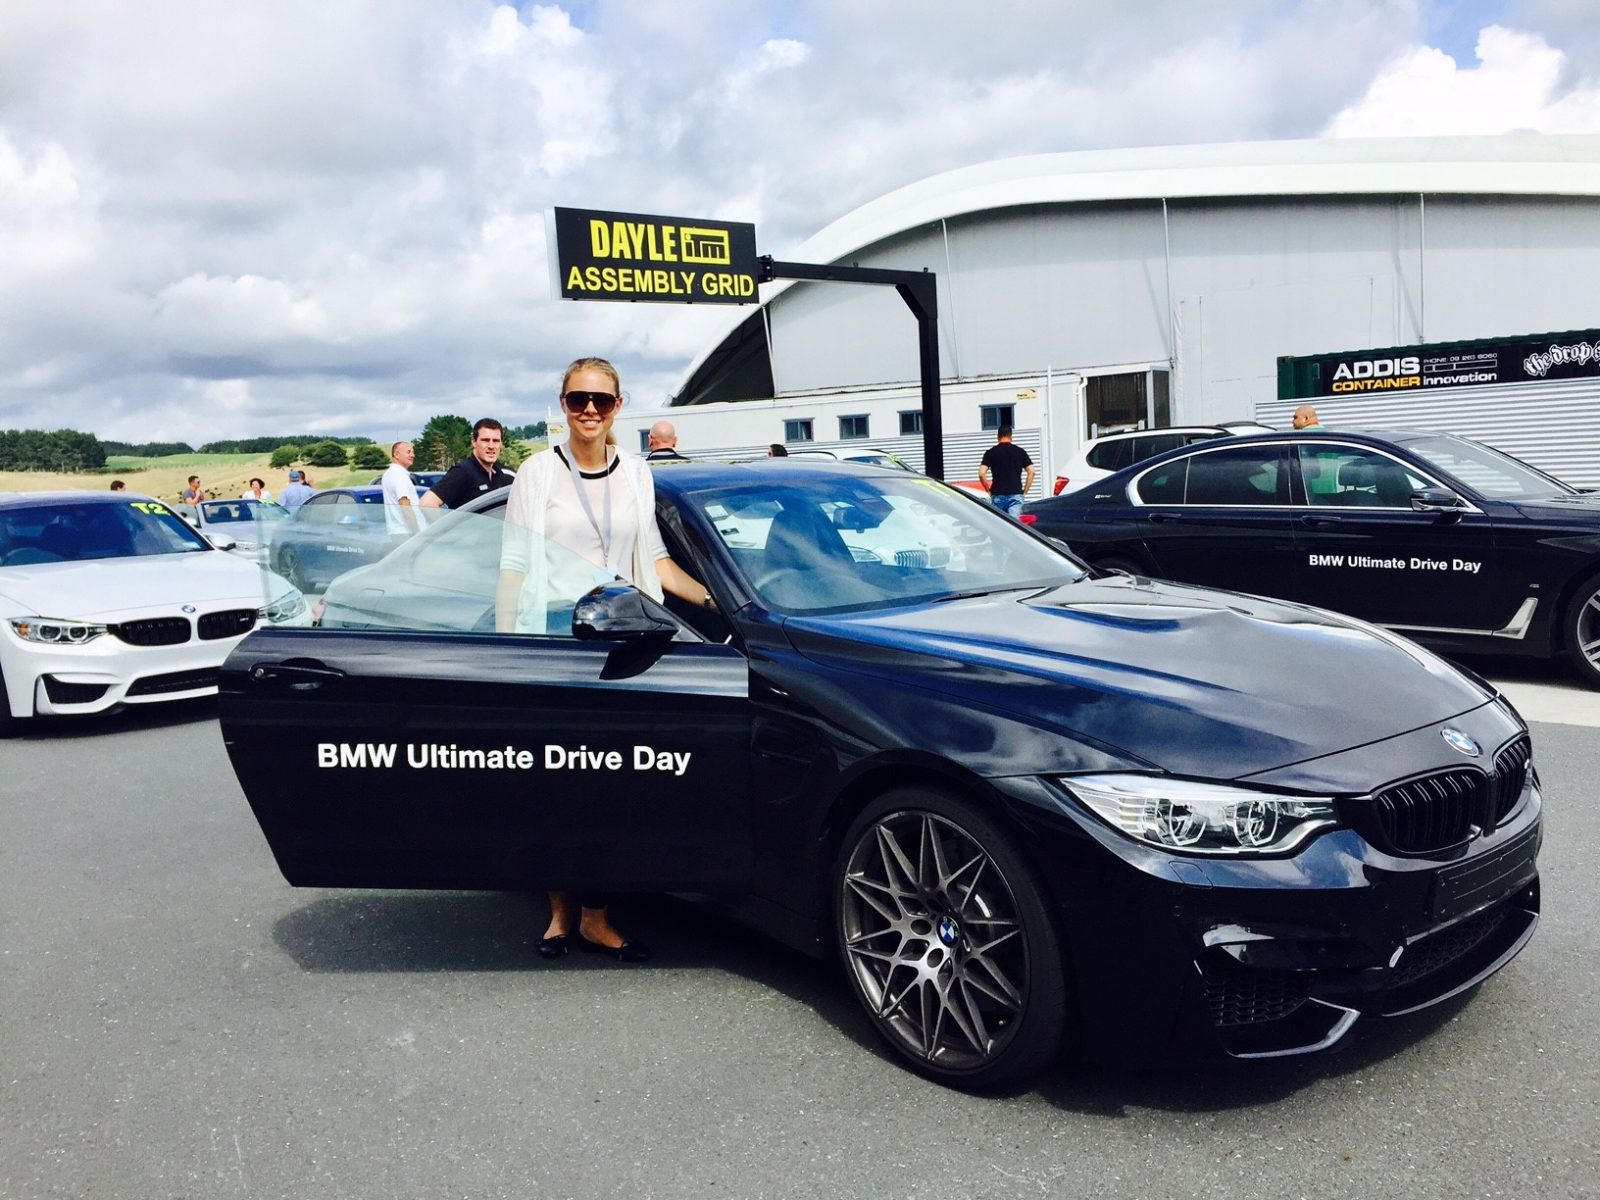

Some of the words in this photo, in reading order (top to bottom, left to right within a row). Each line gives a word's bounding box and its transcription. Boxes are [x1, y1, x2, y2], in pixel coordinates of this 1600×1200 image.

[590, 219, 678, 262] DAYLE
[567, 266, 696, 295] ASSEMBLY
[701, 272, 754, 297] GRID
[1549, 342, 1593, 365] drop
[1333, 357, 1420, 380] ADDIS
[1423, 371, 1498, 386] innovation
[1332, 376, 1421, 392] CONTAINER
[130, 502, 170, 516] T2
[1309, 554, 1344, 567] BMW
[1348, 556, 1406, 570] Ultimate
[1410, 557, 1448, 571] Drive
[1452, 559, 1482, 574] Day
[317, 743, 397, 768] BMW
[407, 744, 534, 769] Ultimate
[544, 745, 623, 770] Drive
[633, 746, 692, 776] Day
